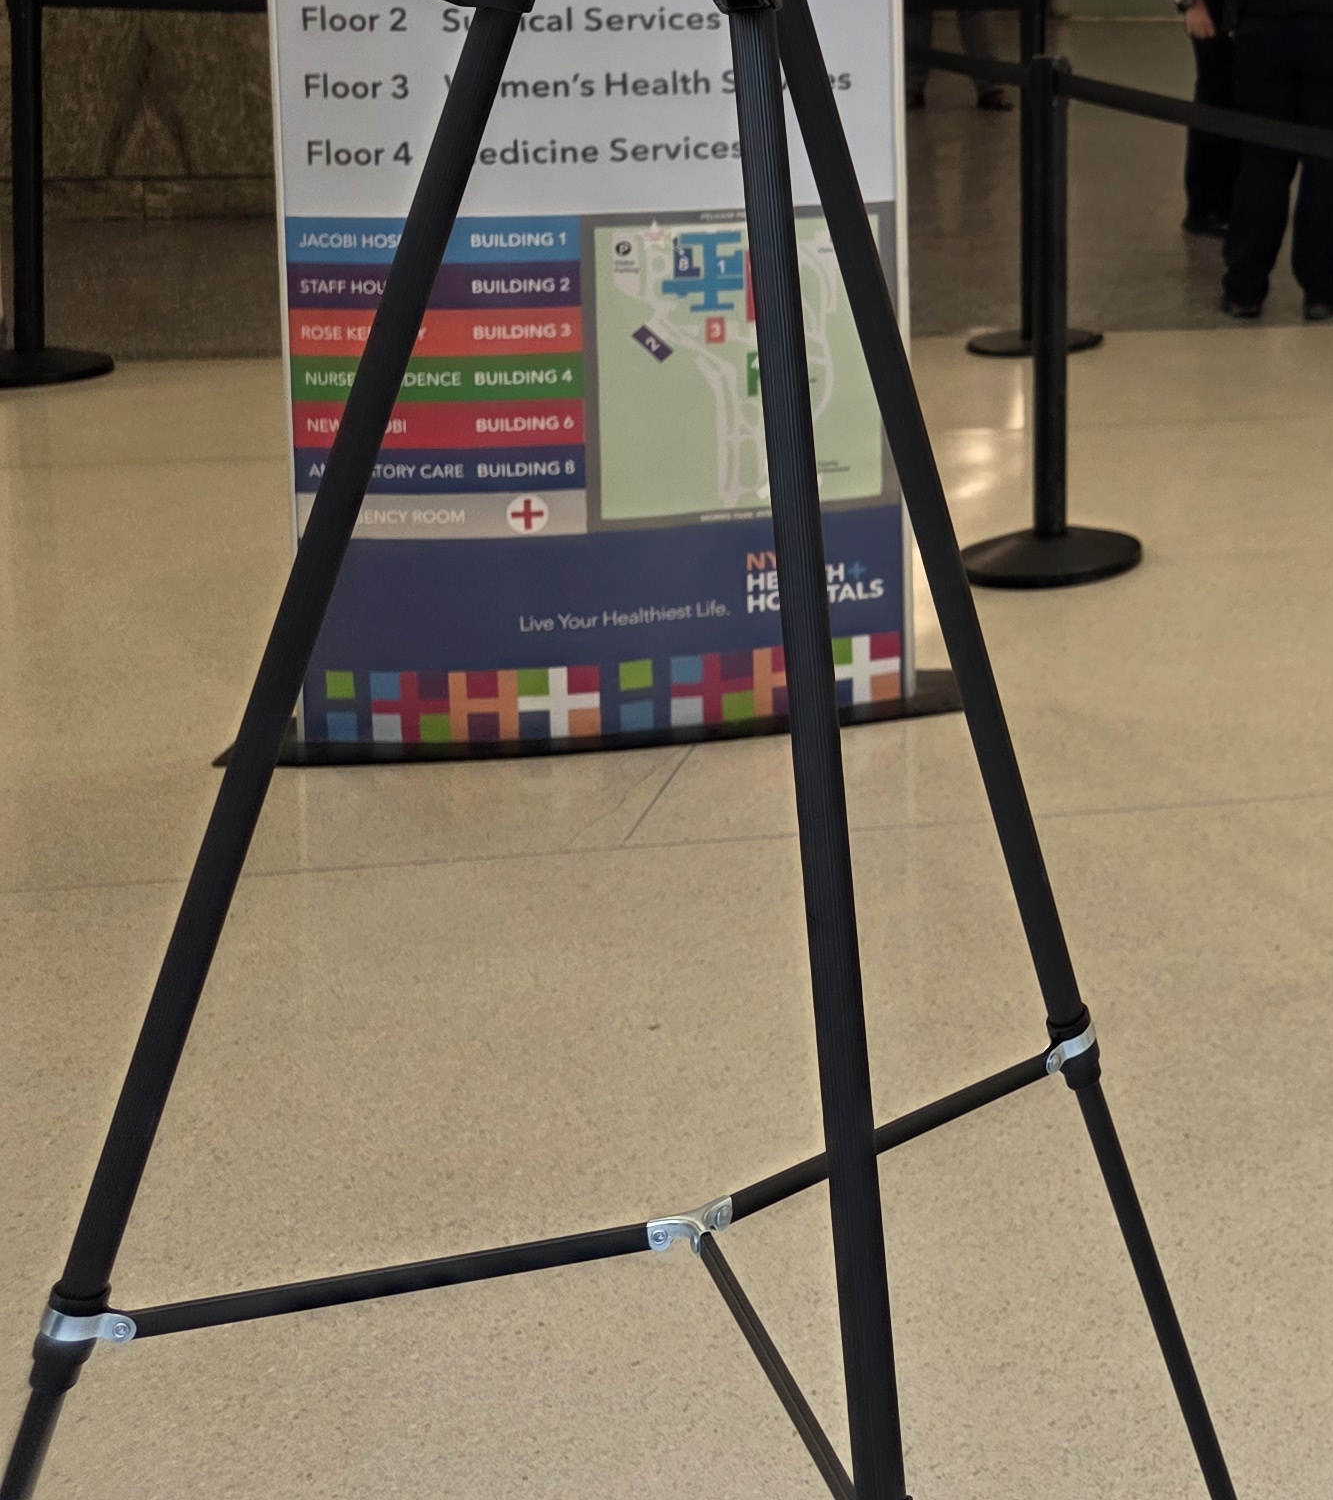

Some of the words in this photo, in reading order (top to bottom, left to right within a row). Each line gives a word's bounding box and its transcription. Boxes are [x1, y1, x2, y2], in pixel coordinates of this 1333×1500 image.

[301, 5, 380, 32] Floor
[389, 7, 407, 32] 2
[584, 6, 721, 32] Services
[304, 72, 383, 99] Floor
[390, 73, 409, 100] 3
[443, 72, 595, 99] men's
[604, 69, 711, 97] Health
[307, 139, 384, 166] Floor
[392, 140, 413, 166] 4
[474, 137, 599, 166] edicine
[609, 136, 741, 163] Services
[299, 232, 357, 249] JACOBI
[470, 233, 555, 248] BUILDING
[558, 232, 567, 246] 1
[717, 258, 726, 274] 1
[299, 278, 346, 295] STAFF
[471, 278, 556, 295] BUILDING
[559, 276, 571, 293] 2
[301, 324, 343, 341] ROSE
[472, 324, 557, 341] BUILDING
[561, 322, 573, 338] 3
[644, 336, 662, 353] 2
[474, 370, 557, 386] BUILDING
[561, 368, 573, 383] 4
[475, 416, 560, 433] BUILDING
[563, 414, 574, 431] 6
[419, 463, 465, 479] CARE
[476, 462, 560, 478] BUILDING
[564, 460, 576, 476] 8
[412, 508, 466, 526] ROOM
[519, 614, 555, 632] Live
[557, 612, 598, 630] Your
[602, 602, 693, 627] Healthiest
[695, 599, 731, 617] Life.
